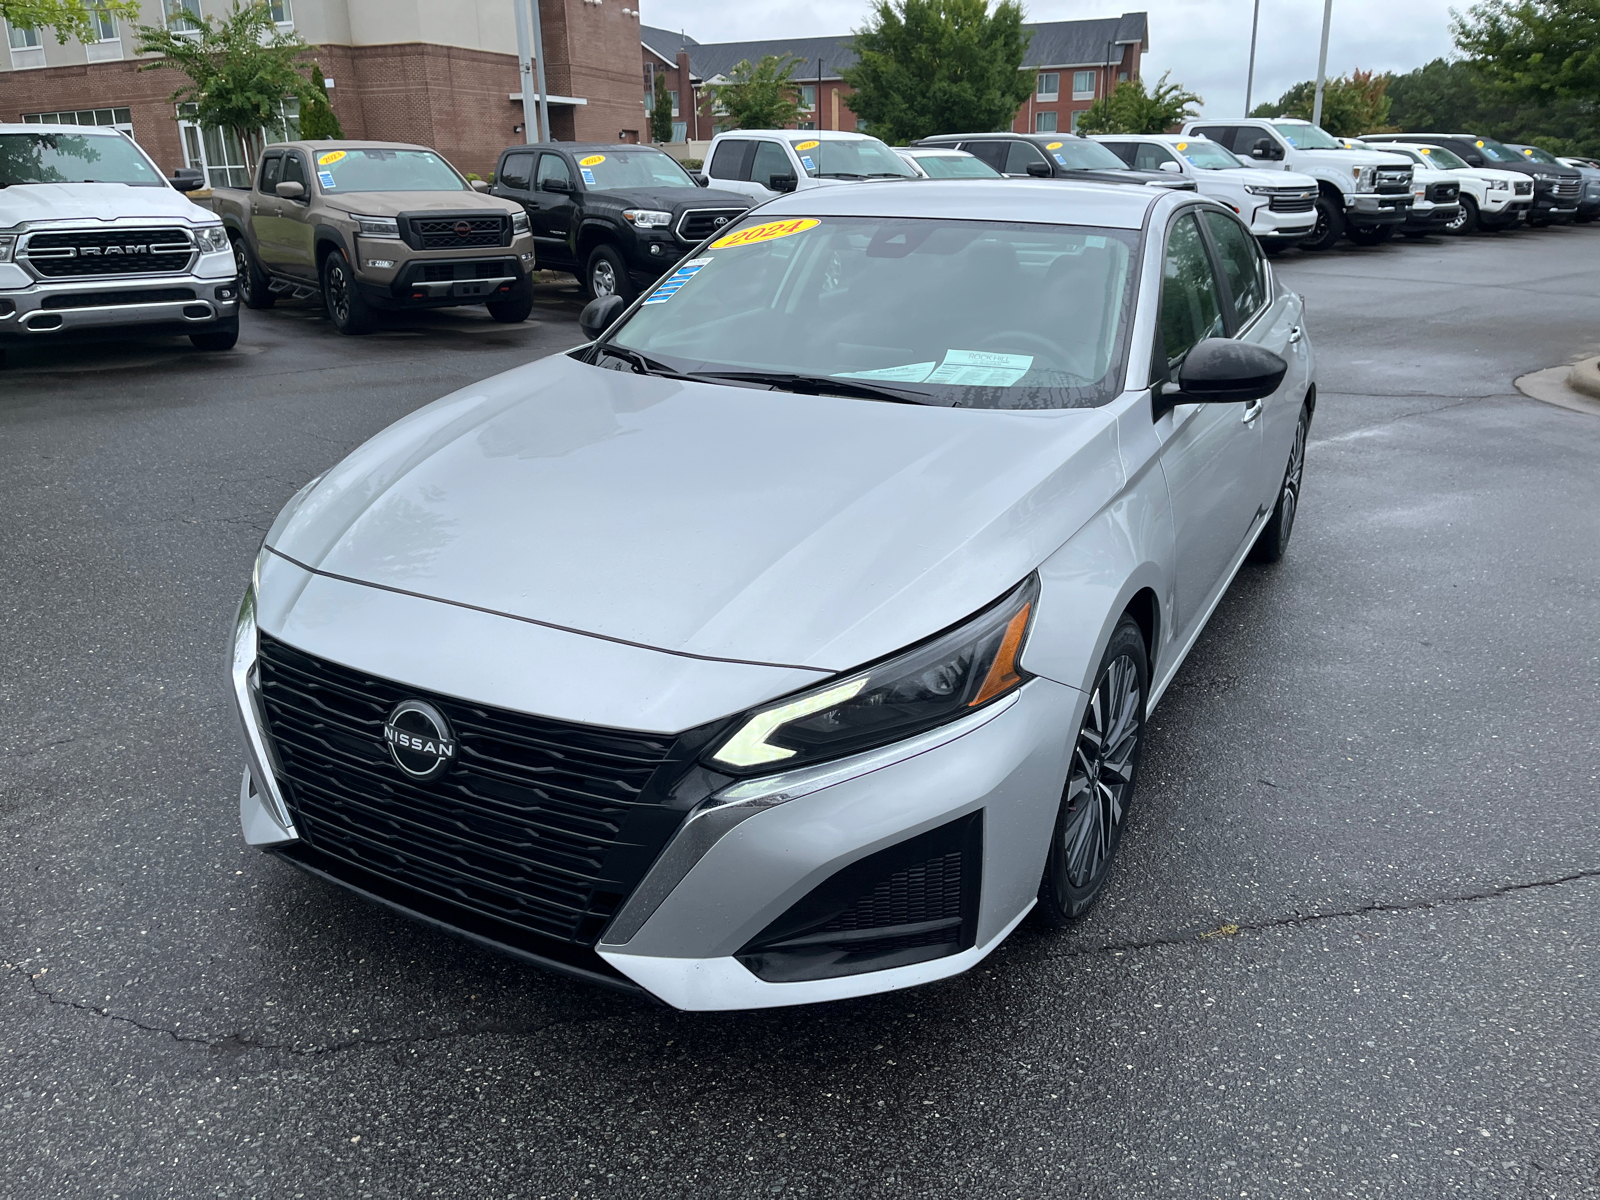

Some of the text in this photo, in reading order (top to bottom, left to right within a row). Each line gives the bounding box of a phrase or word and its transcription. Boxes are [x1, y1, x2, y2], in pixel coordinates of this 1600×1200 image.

[724, 220, 804, 246] 2024
[80, 244, 147, 256] RAM
[968, 353, 992, 361] ROCK
[384, 726, 453, 756] NISSAN
